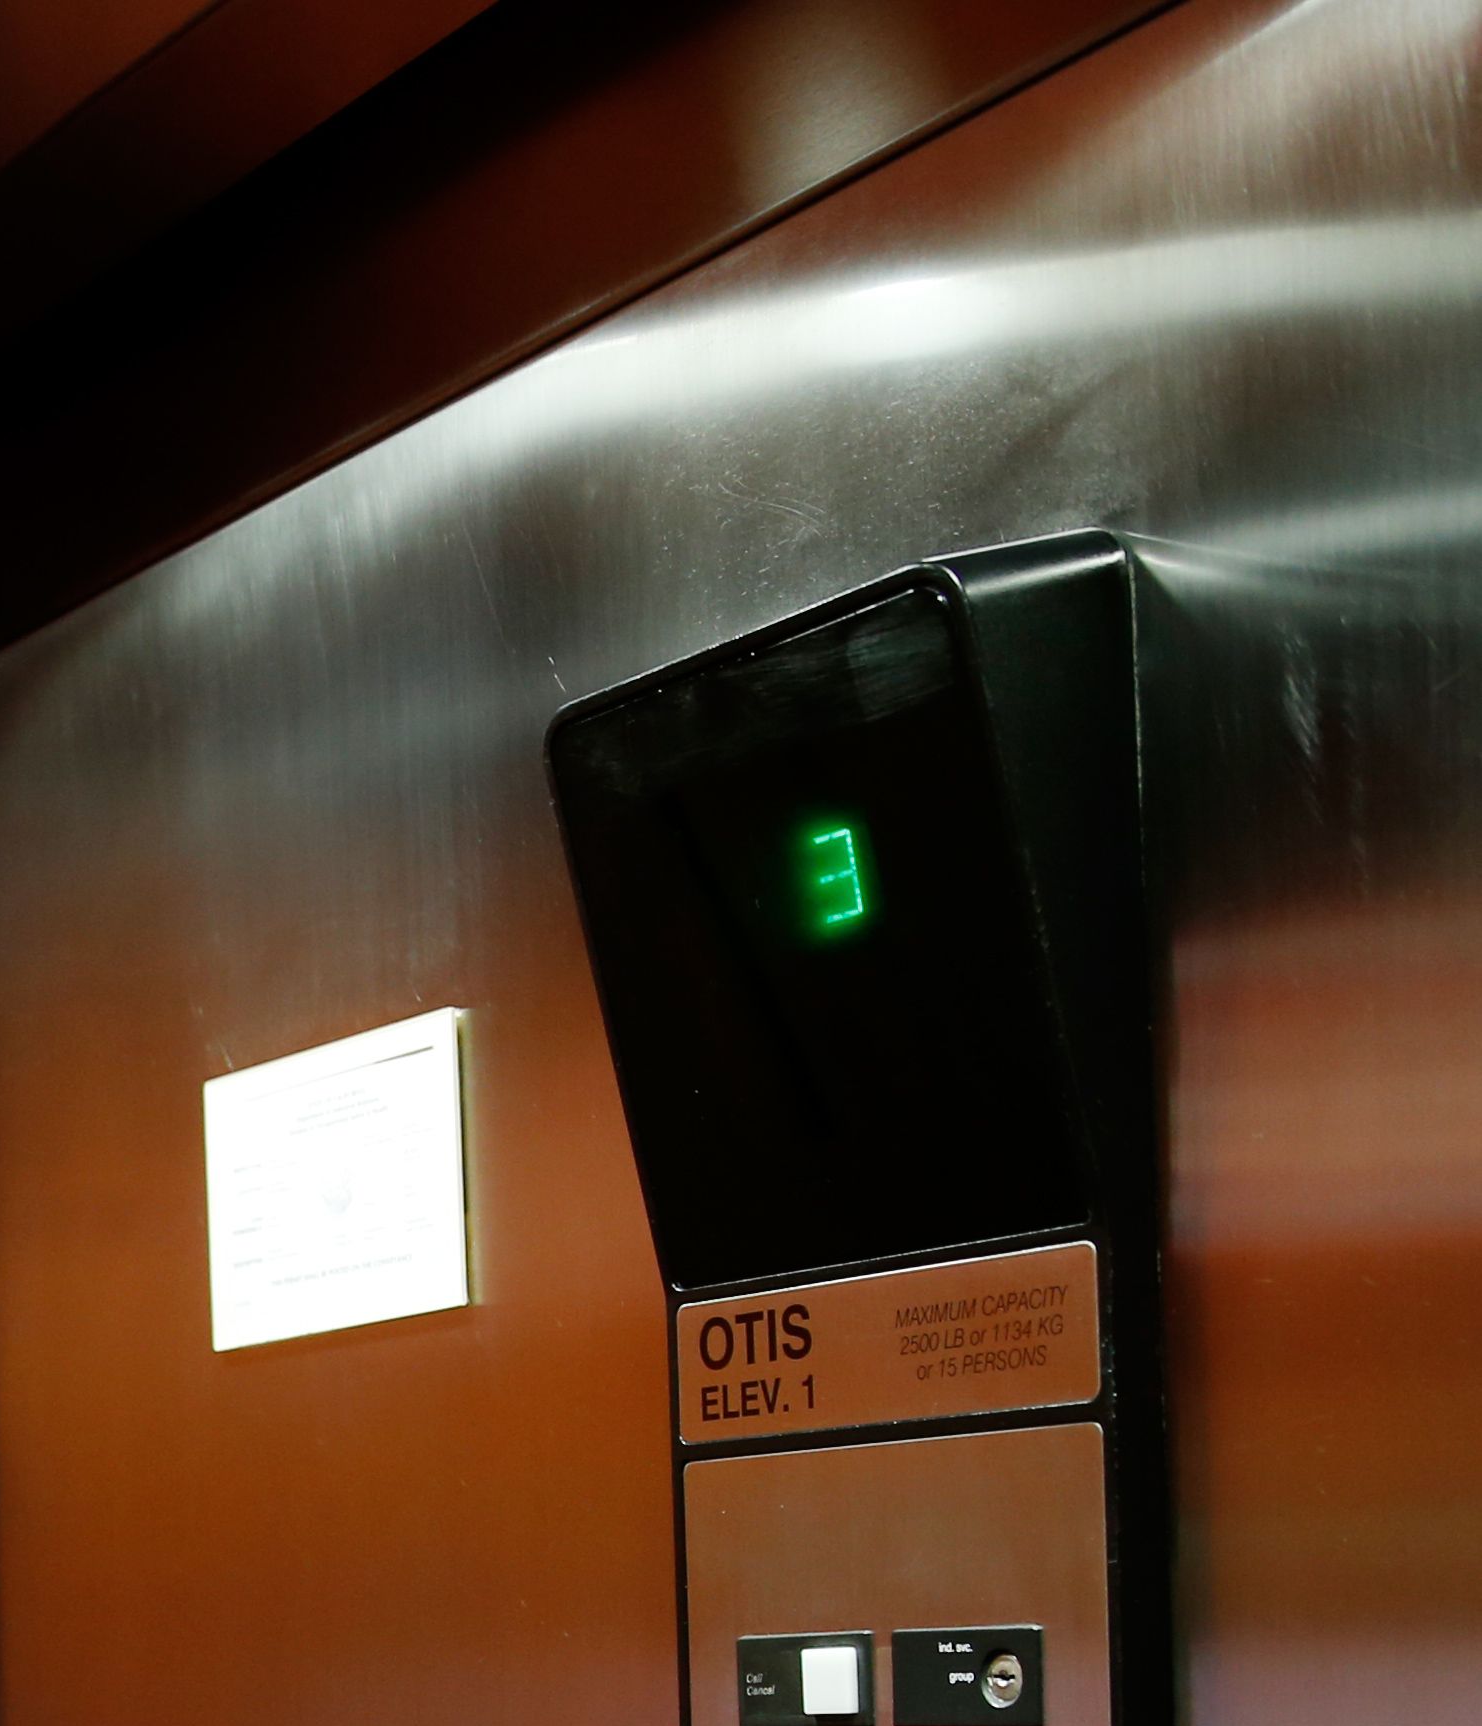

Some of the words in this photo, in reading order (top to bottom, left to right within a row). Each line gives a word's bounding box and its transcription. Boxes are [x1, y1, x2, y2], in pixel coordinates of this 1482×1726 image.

[813, 828, 863, 924] 3
[895, 1298, 977, 1328] MAXIMUM
[981, 1285, 1068, 1317] CAPACITY
[699, 1303, 812, 1371] OTIS
[900, 1332, 939, 1356] 2500
[944, 1327, 965, 1349] LB
[969, 1329, 987, 1346] or
[993, 1319, 1032, 1342] 1134
[1037, 1313, 1064, 1337] KG
[917, 1363, 933, 1380] or
[939, 1356, 957, 1379] 15
[962, 1344, 1047, 1375] PERSONS
[701, 1377, 789, 1422] ELEV.
[801, 1374, 814, 1409] 1
[949, 1672, 975, 1684] group
